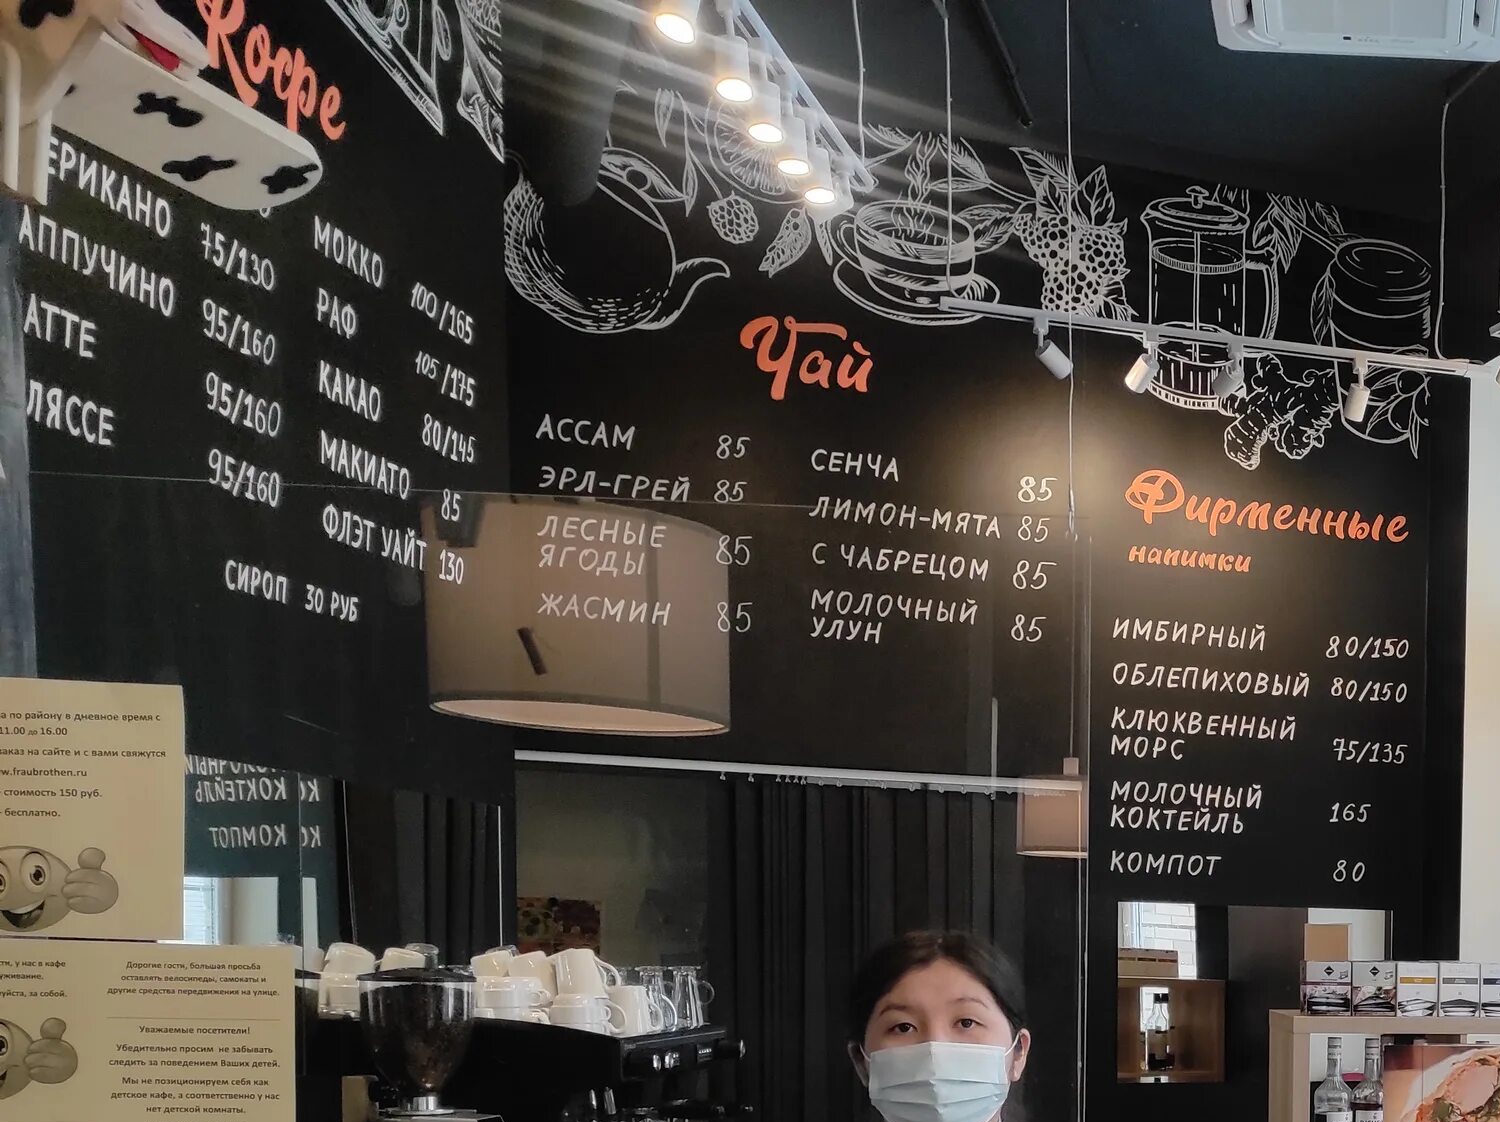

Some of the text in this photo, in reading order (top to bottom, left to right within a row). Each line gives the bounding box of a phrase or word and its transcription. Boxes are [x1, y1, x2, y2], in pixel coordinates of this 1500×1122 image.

[197, 0, 346, 140] Кофе
[48, 136, 171, 238] ЕРИКАНО
[19, 204, 175, 317] АППУЧИНО
[201, 223, 274, 290] 75/130
[315, 216, 383, 287] МОККО
[23, 293, 97, 358] АТТЕ
[203, 299, 275, 365] 95/160
[317, 288, 356, 339] РАФ
[740, 316, 874, 401] Чай
[206, 372, 281, 437] 95/160
[319, 360, 380, 421] КАКАО
[27, 379, 115, 446] ЛЯССЕ
[422, 414, 476, 462] 80/145
[536, 414, 750, 459] АССАМ 85
[208, 449, 280, 507] 95/160
[321, 430, 409, 499] МАКИАТО
[538, 466, 747, 503] ЭРЛ-ГРЕЙ 85
[812, 449, 1058, 502] СЕНЧА 85
[442, 491, 461, 522] 85
[809, 496, 1050, 543] ЛИМОН-МЯТА 85
[1125, 469, 1409, 543] Фирменные
[323, 504, 464, 585] ФЛЭТ УАЙТ 130
[537, 516, 667, 548] ЛЕСНЫЕ
[538, 535, 752, 578] ЯГОДЫ 85
[812, 543, 1057, 589] С ЧАБРЕЦОМ 85
[1128, 544, 1251, 573] напитки
[225, 560, 358, 621] СИРОП 30 РУБ
[811, 589, 978, 625] МОЛОЧНЫЙ
[537, 593, 752, 633] ЖАСМИН 85
[811, 614, 1046, 643] УЛУН 85
[1113, 618, 1408, 659] ИМБИРНЫЙ 80/150
[1113, 663, 1407, 702] ОБЛЕПИХОВЫЙ 80/150
[9, 712, 22, 720] по
[25, 711, 62, 722] району
[74, 714, 119, 722] дневное
[122, 714, 153, 722] время
[40, 727, 68, 736] 16.00
[1112, 707, 1296, 741] КЛЮКВЕННЫЙ
[42, 747, 71, 757] сайте
[91, 750, 119, 758] вами
[121, 751, 166, 759] свяжутся
[1111, 735, 1407, 764] МОРС 75/135
[4, 789, 102, 799] стоимость 150 руб.
[4, 808, 61, 817] бесплатно.
[1111, 781, 1262, 809] МОЛОЧНЫЙ
[1111, 803, 1371, 833] КОКТЕЙЛЬ 165
[1111, 851, 1365, 881] КОМПОТ 80
[139, 1025, 251, 1035] Уважаемые посетители!
[109, 1059, 146, 1067] следить
[160, 1060, 218, 1068] поведением
[220, 1059, 250, 1067] Ваших
[252, 1059, 281, 1068] детей.
[163, 1104, 200, 1114] детской
